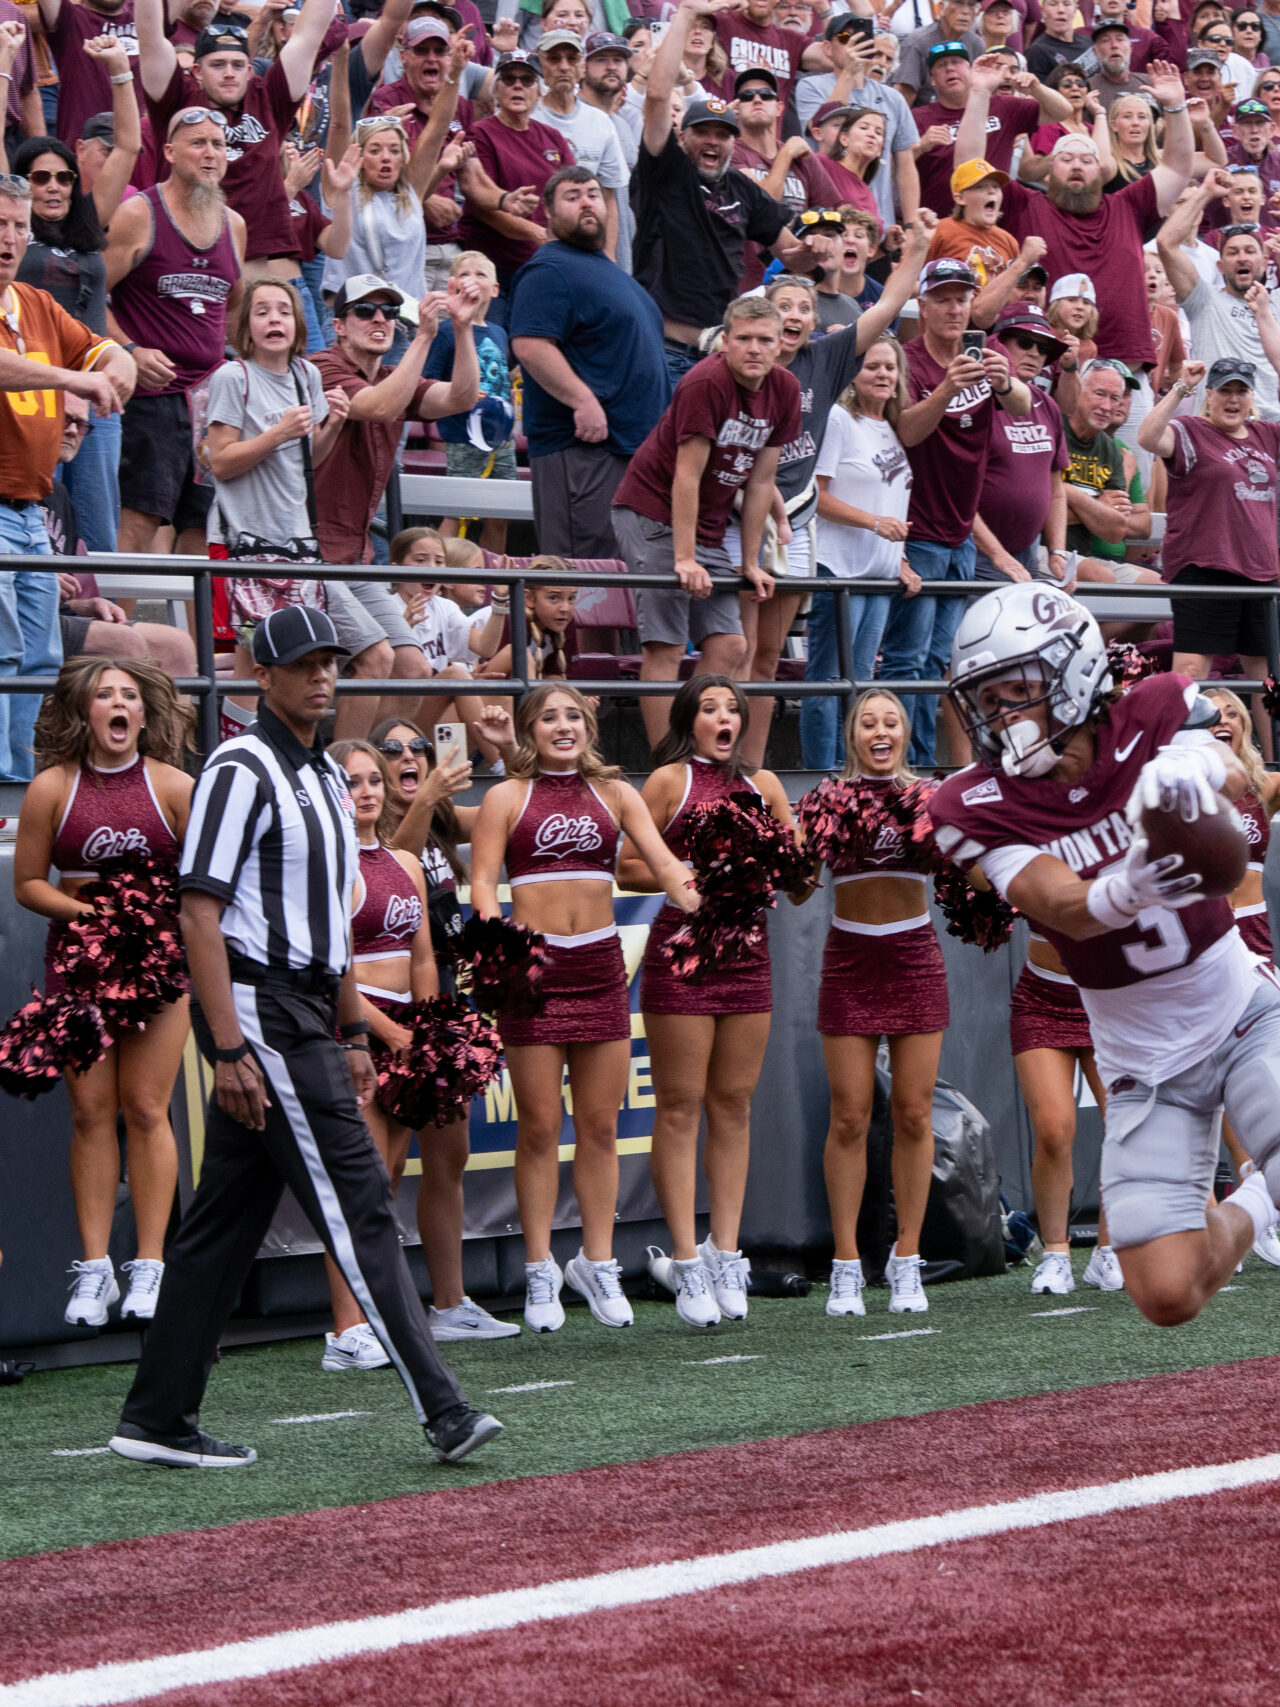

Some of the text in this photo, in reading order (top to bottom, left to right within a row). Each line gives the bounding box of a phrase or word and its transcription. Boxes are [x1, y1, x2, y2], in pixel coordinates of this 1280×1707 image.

[1004, 425, 1052, 442] GRIZ
[295, 789, 311, 807] S
[82, 826, 152, 863] Griz
[535, 814, 602, 858] Griz
[1040, 811, 1136, 872] MONTA
